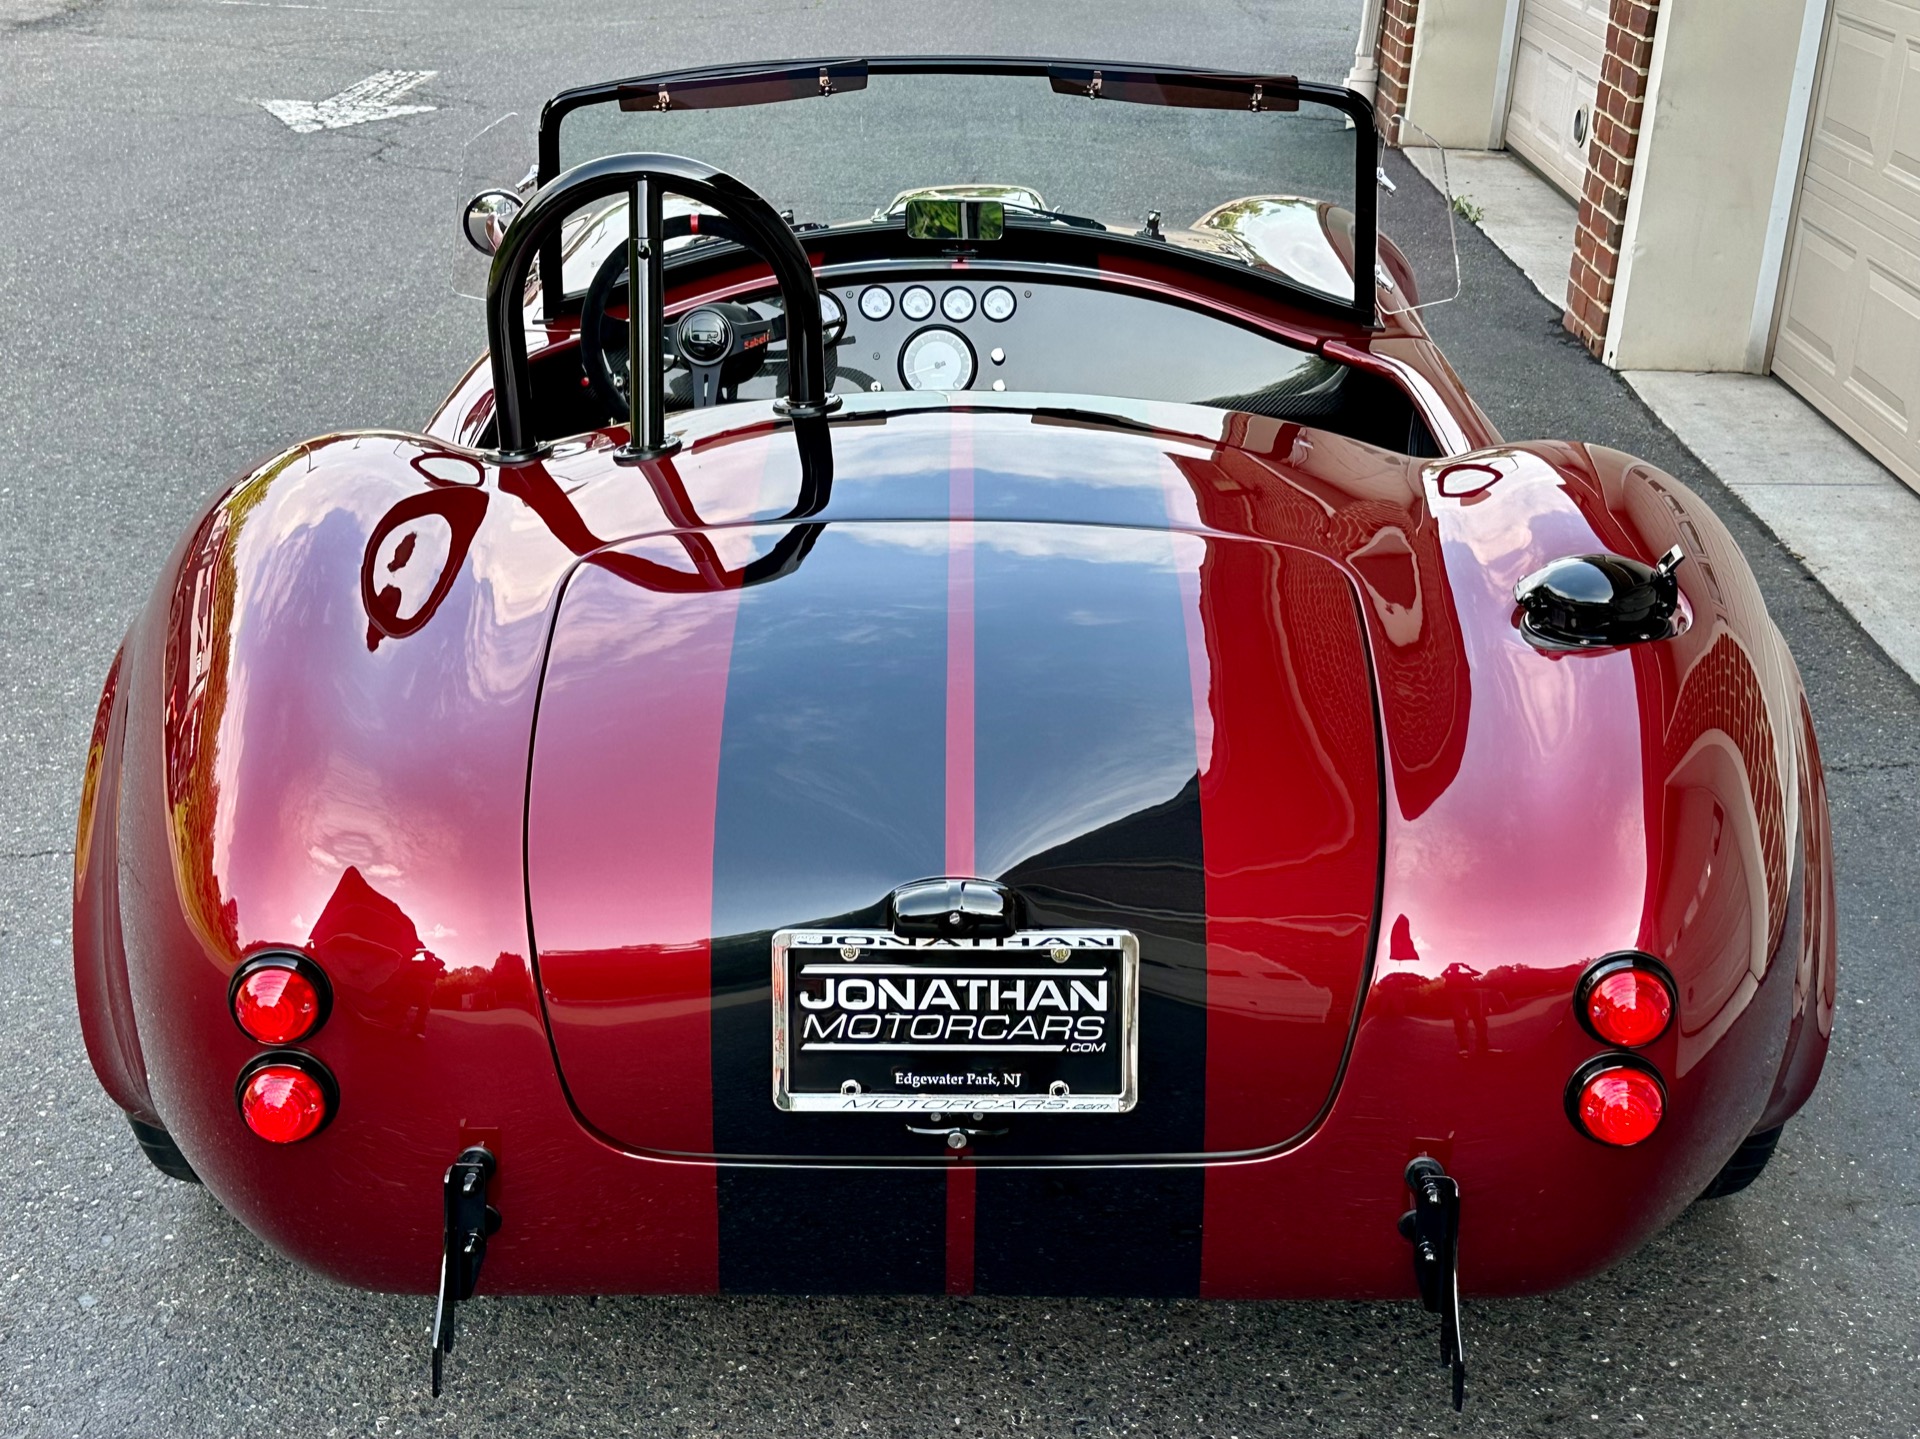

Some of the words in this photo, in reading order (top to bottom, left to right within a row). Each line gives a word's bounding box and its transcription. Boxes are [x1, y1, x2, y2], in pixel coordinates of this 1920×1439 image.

[800, 978, 1107, 1012] JONATHAN
[802, 1013, 1105, 1041] MOTORCARS
[1065, 1042, 1107, 1053] .COM
[894, 1072, 963, 1087] Edgewater
[966, 1072, 1001, 1087] Park,
[1003, 1072, 1022, 1087] NJ
